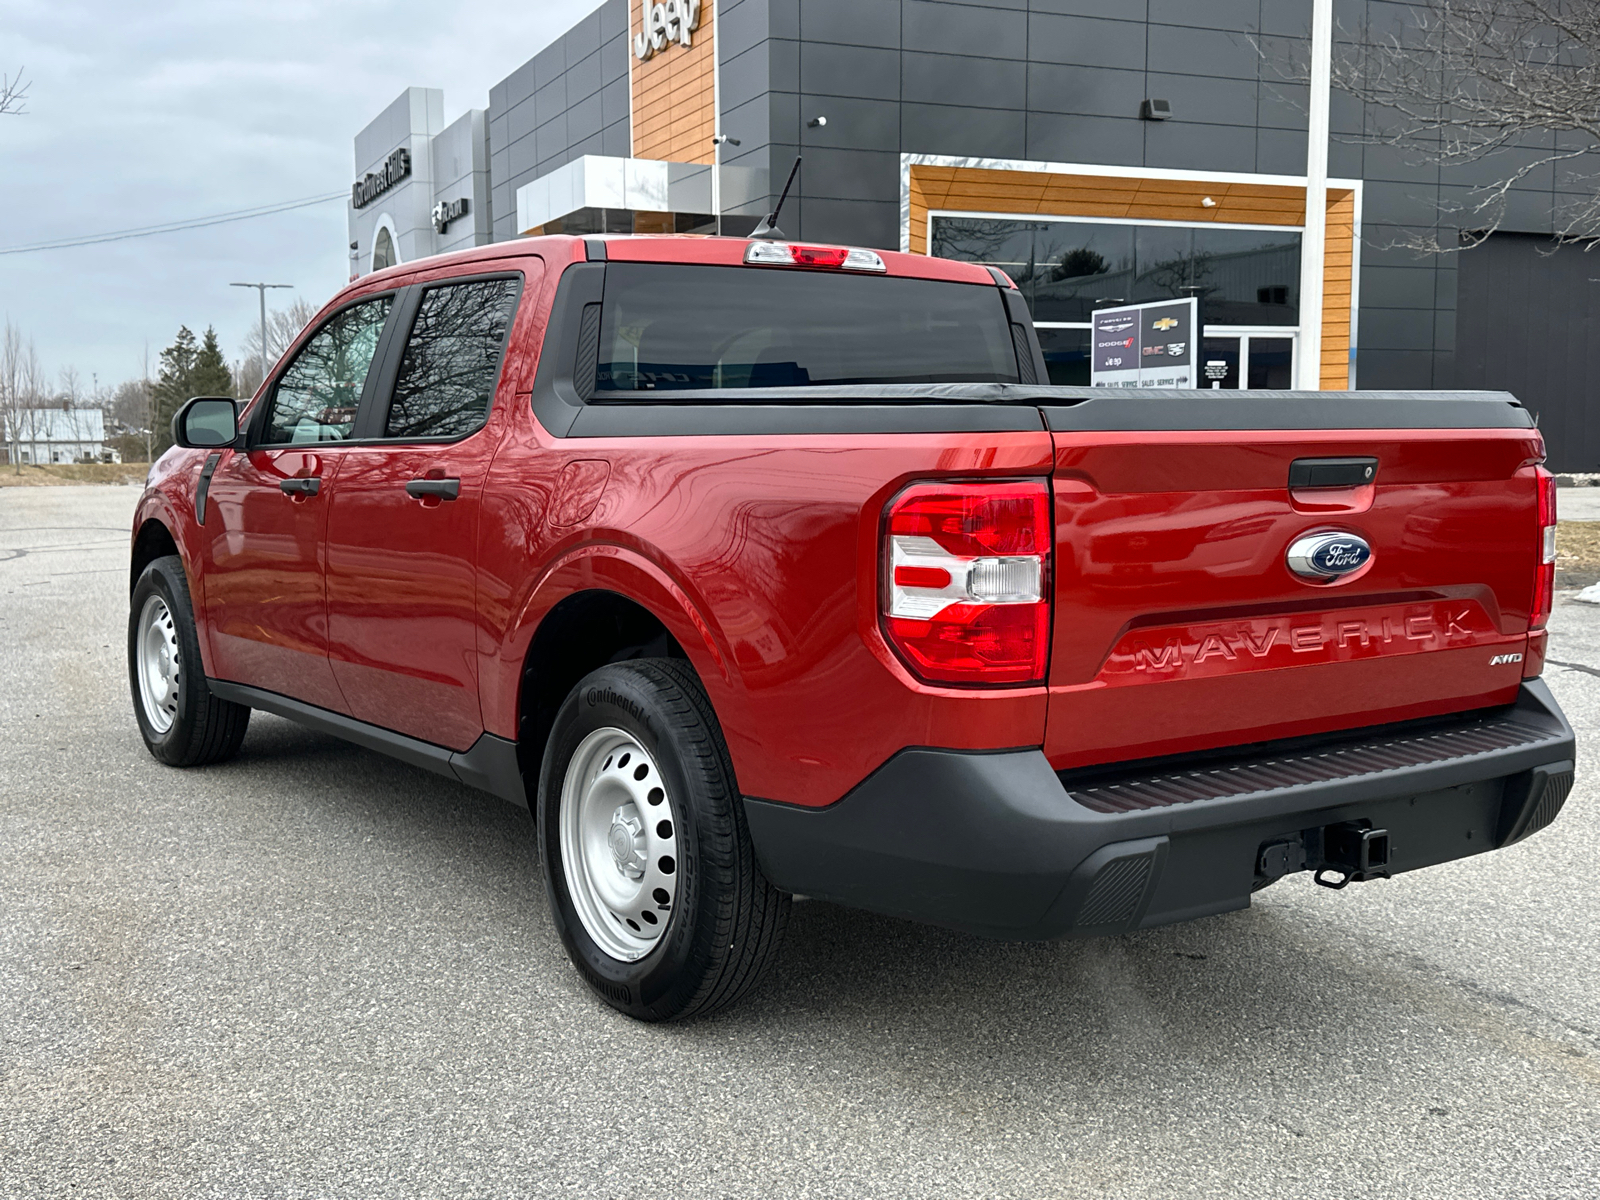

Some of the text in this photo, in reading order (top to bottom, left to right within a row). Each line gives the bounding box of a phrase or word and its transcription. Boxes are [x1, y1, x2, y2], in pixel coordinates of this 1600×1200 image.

[634, 0, 700, 61] Jeep
[388, 148, 410, 185] Hills
[442, 198, 467, 223] RAM
[1098, 340, 1129, 348] DODGE
[1142, 345, 1164, 356] GMC
[1105, 357, 1122, 366] Jeep
[1325, 543, 1361, 567] Ford
[1135, 609, 1473, 672] MAVERICK
[1489, 653, 1522, 666] AWD
[587, 686, 645, 722] Continental
